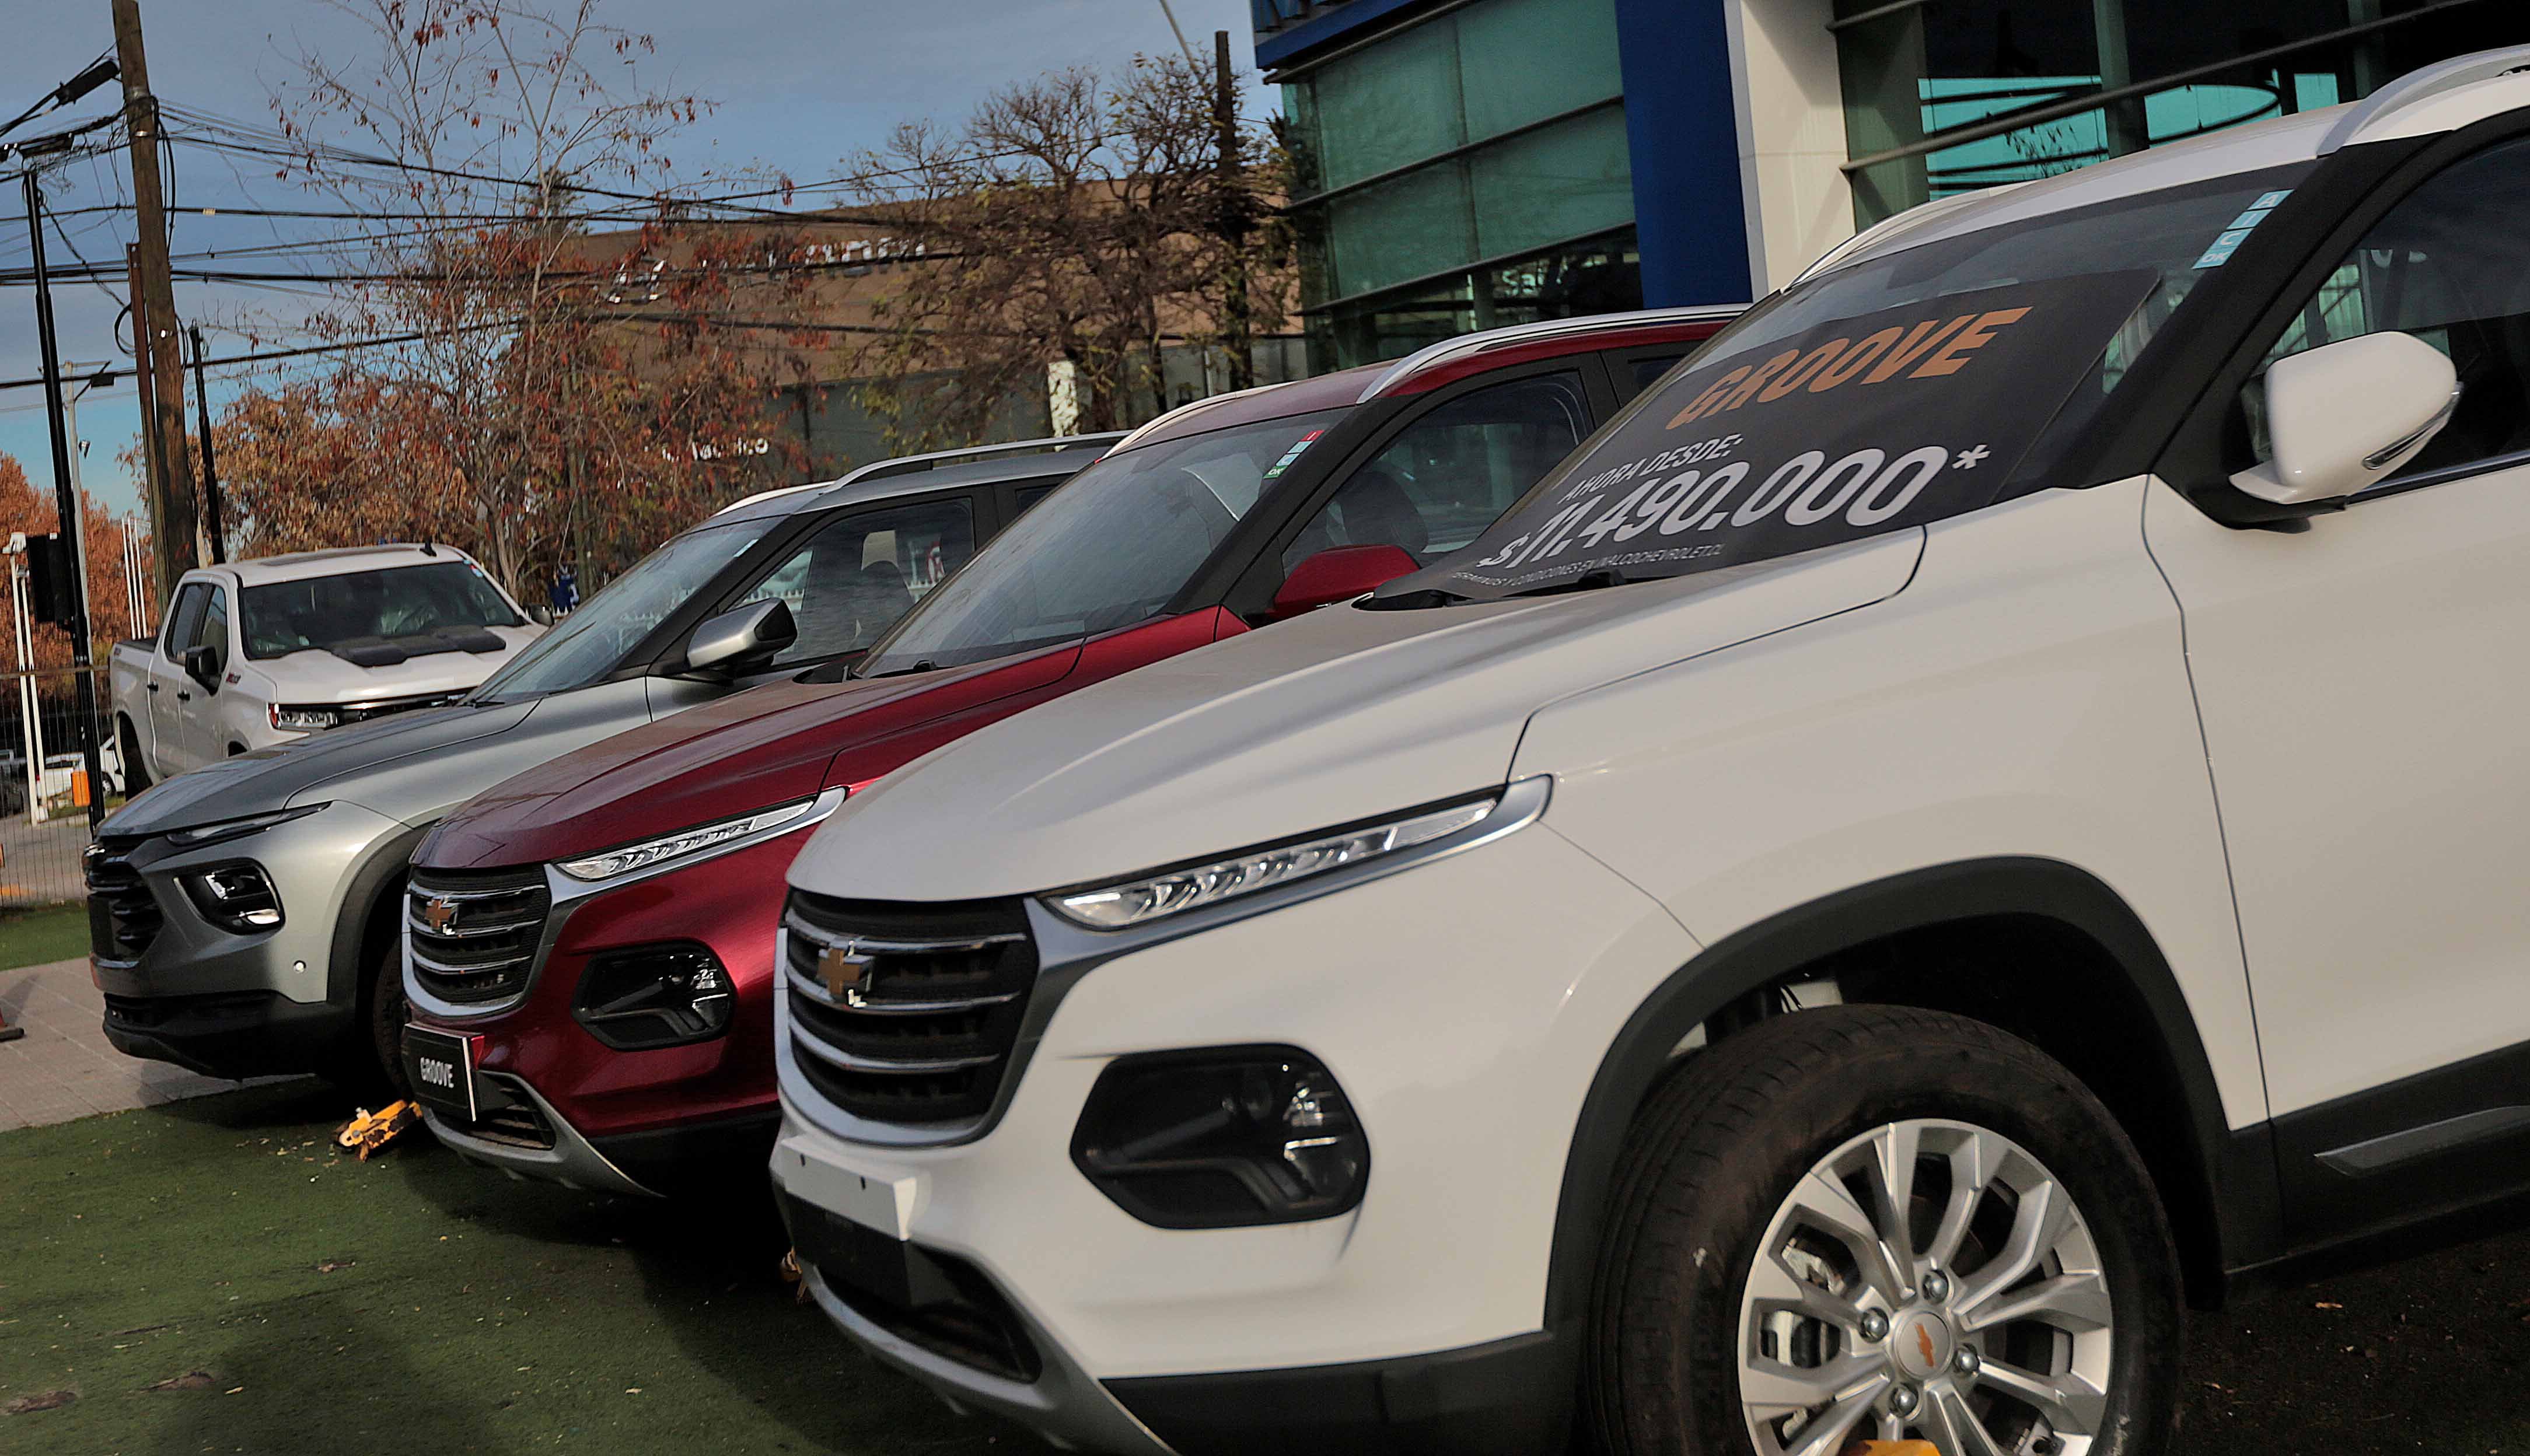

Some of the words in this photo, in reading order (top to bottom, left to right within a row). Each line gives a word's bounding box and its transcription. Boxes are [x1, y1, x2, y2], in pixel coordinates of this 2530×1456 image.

[1666, 306, 2034, 430] GROOVE
[1557, 457, 1647, 505] AHORA
[1639, 433, 1742, 477] DESDE:
